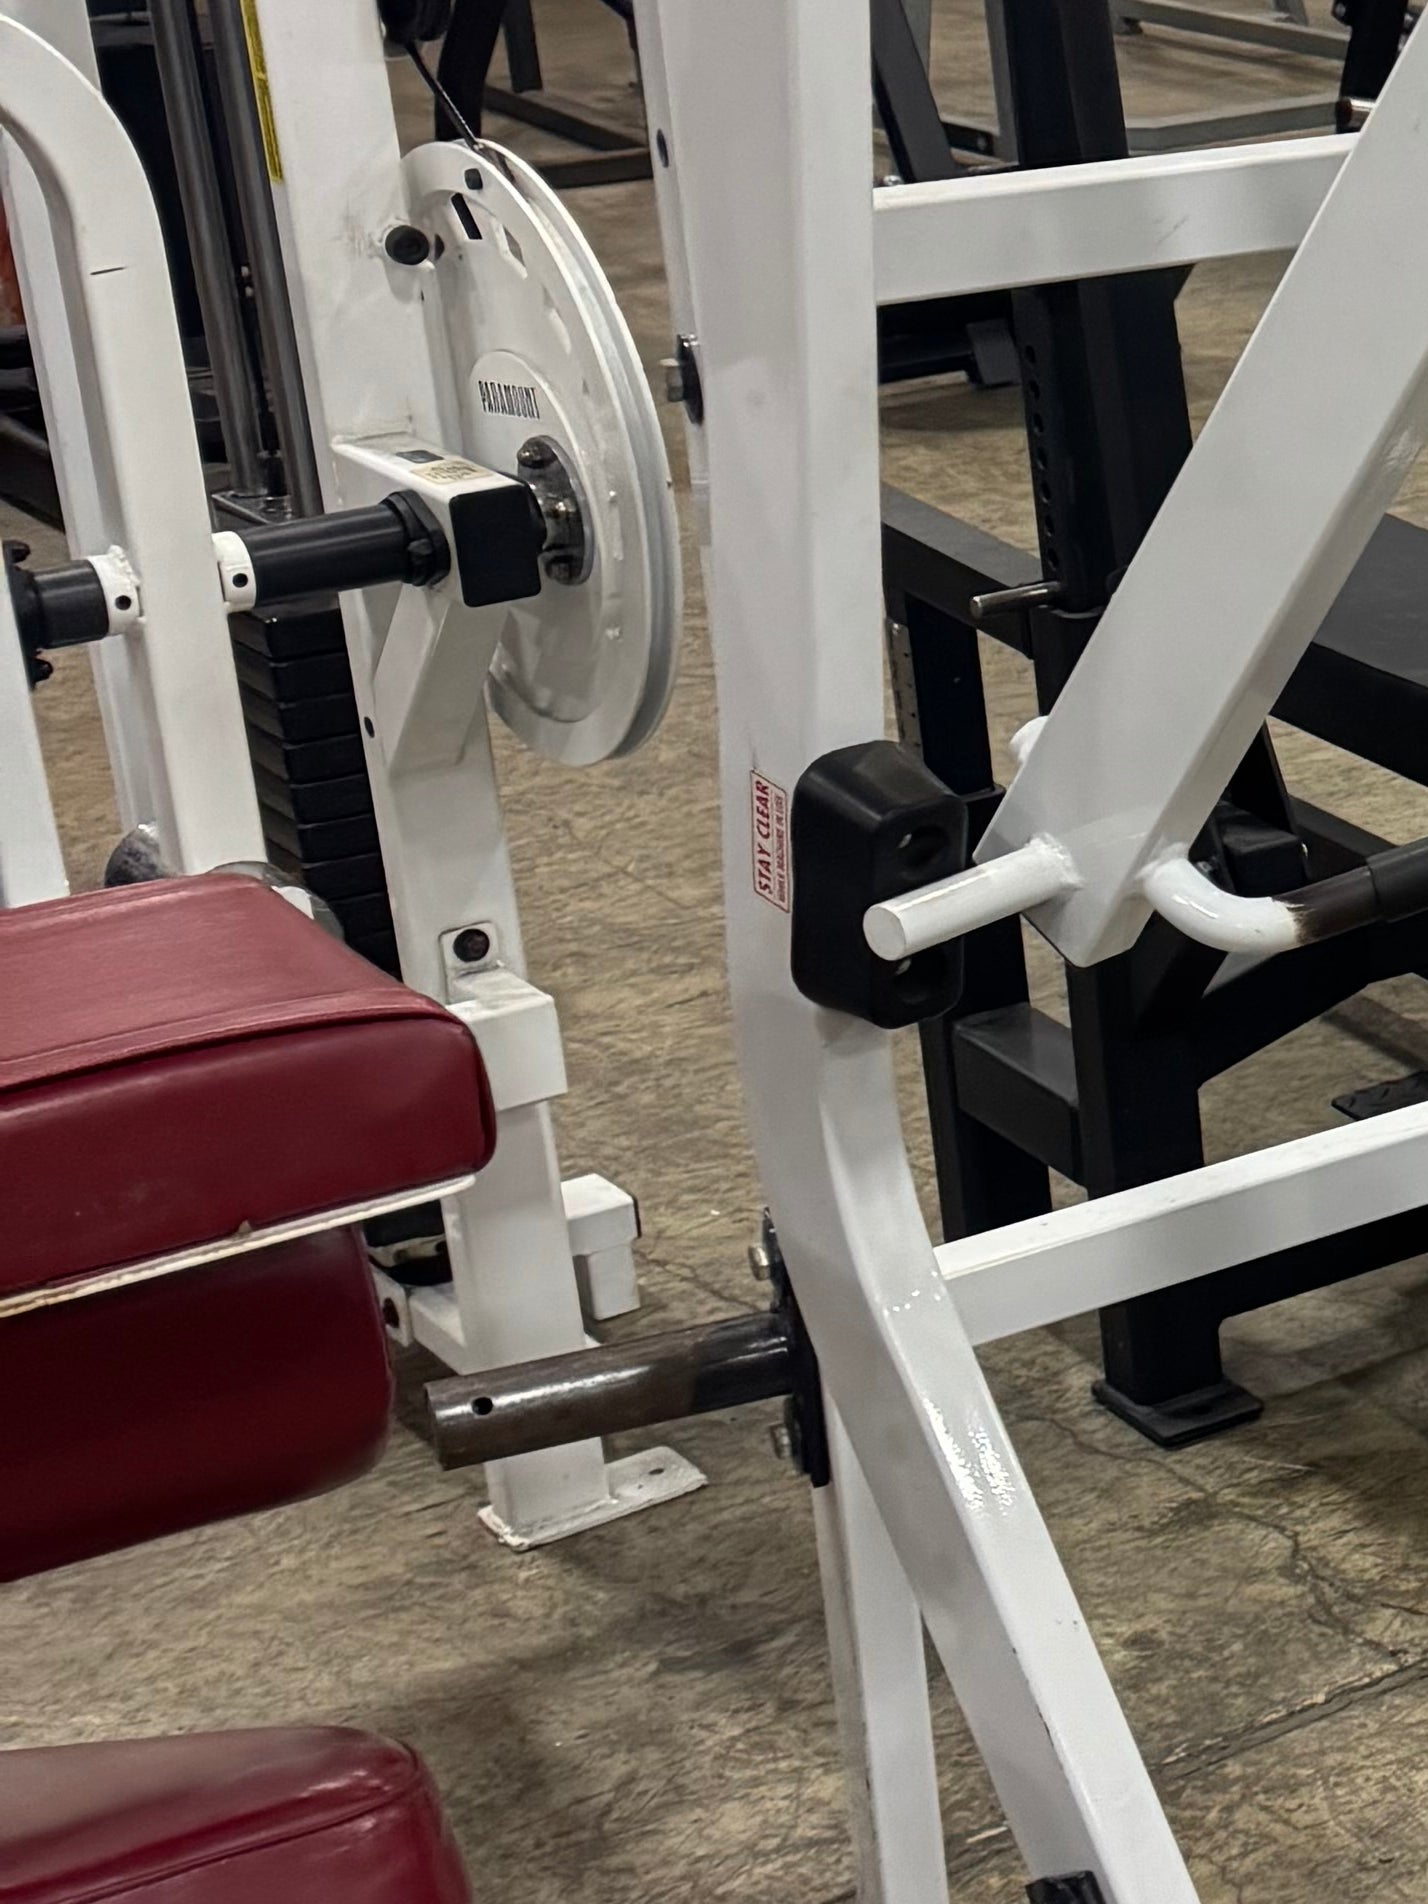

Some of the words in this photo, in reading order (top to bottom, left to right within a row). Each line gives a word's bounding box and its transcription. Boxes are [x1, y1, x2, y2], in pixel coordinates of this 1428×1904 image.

[478, 379, 541, 420] PARAMOUNT
[755, 779, 771, 840] CLEAR
[756, 844, 774, 894] STAY
